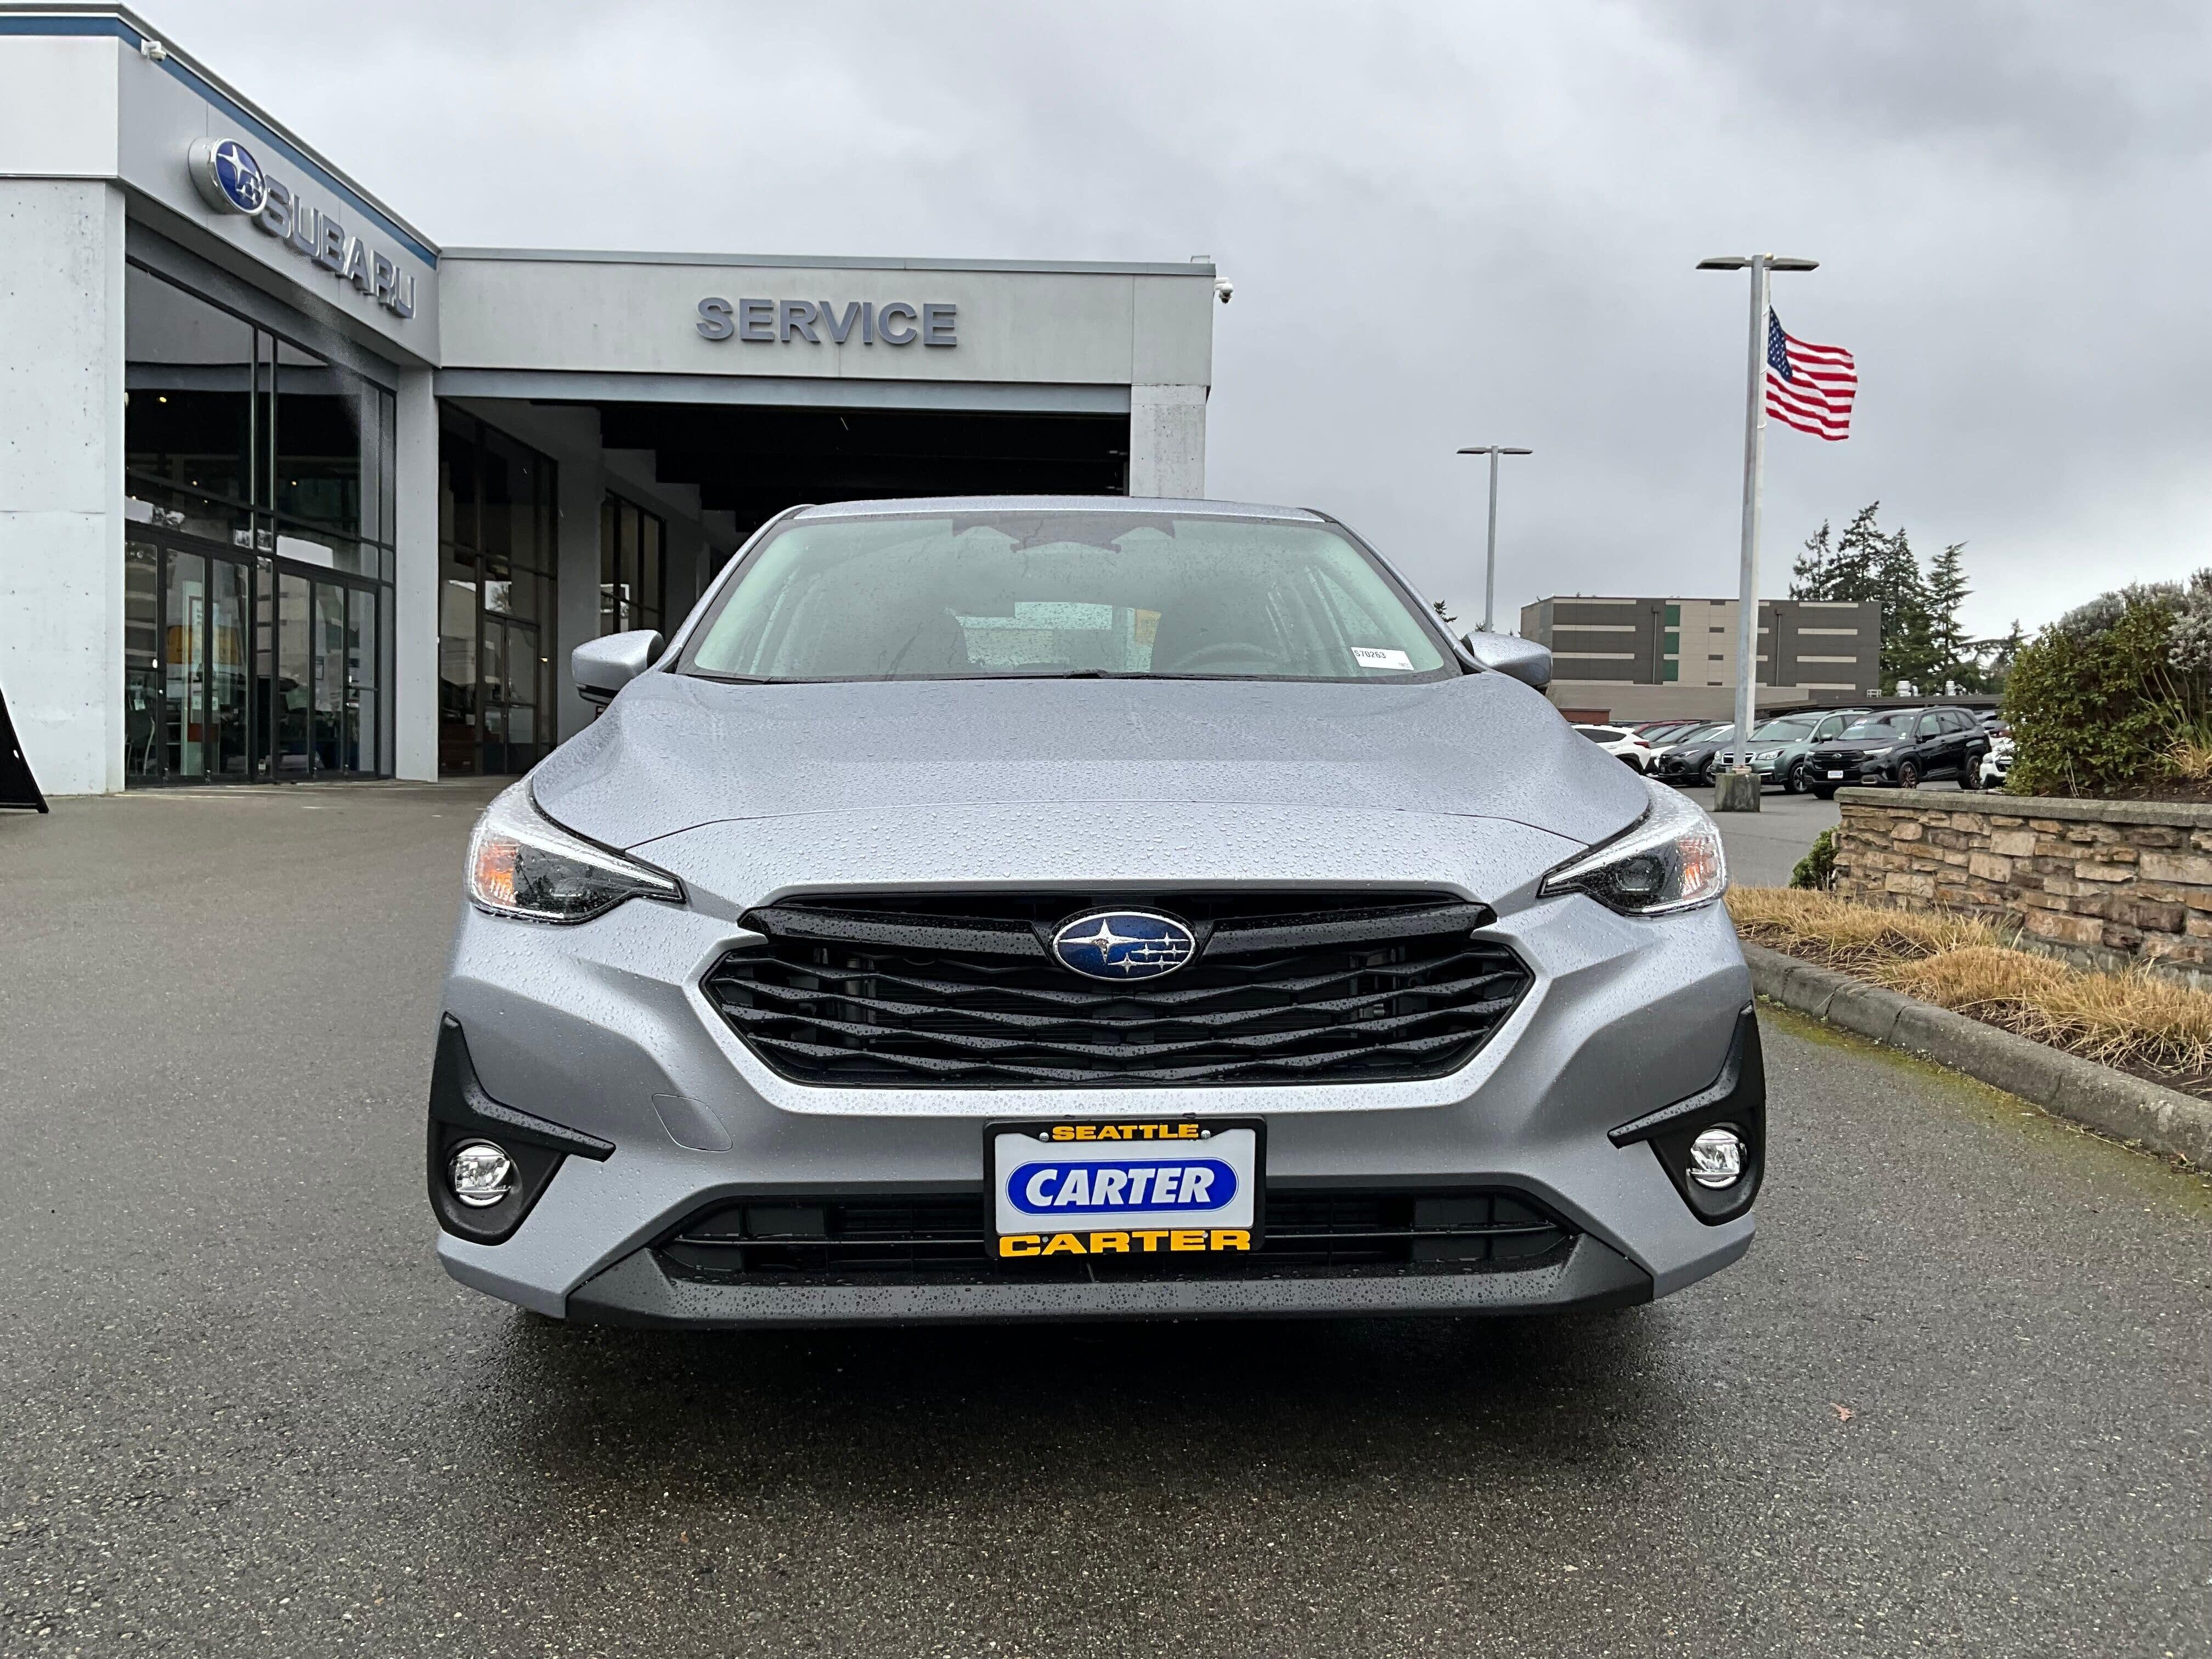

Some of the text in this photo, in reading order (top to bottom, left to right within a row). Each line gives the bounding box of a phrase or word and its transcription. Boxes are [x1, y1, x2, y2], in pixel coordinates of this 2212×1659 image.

[262, 174, 416, 319] SUBARU
[696, 297, 957, 347] SERVICE
[1354, 650, 1386, 658] S70263
[1052, 1124, 1199, 1141] SEATTLE
[1025, 1167, 1215, 1207] CARTER
[999, 1230, 1251, 1257] CARTER
